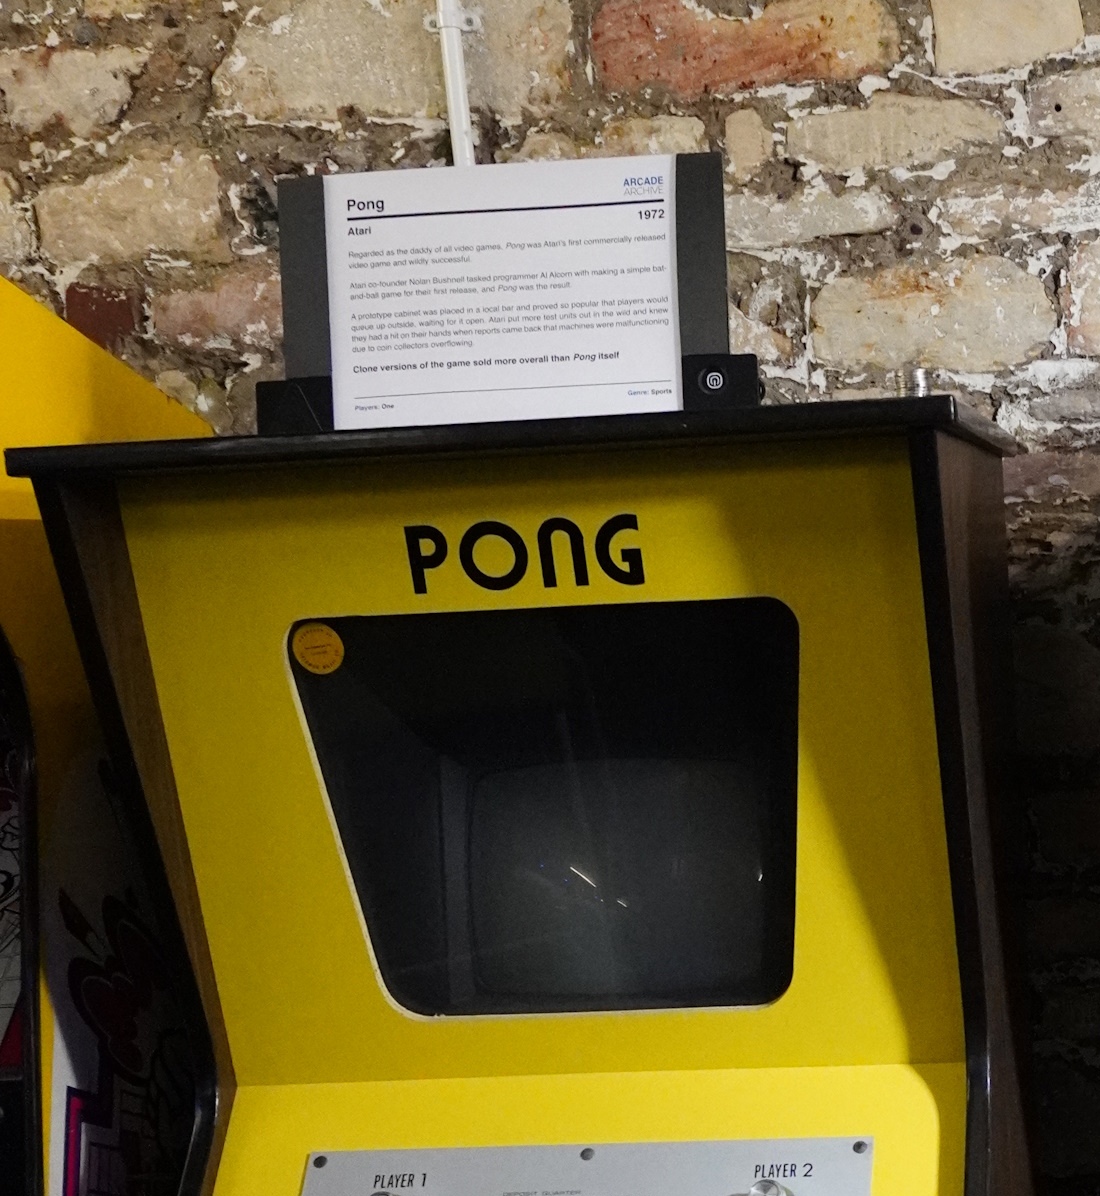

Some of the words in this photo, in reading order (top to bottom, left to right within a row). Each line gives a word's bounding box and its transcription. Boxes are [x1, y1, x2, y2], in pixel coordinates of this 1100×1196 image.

[623, 175, 663, 186] ARCADE
[623, 186, 664, 195] ARCHIVE
[346, 198, 384, 212] Pong
[637, 208, 664, 220] 1972
[347, 225, 371, 236] Atari
[347, 249, 384, 259] Regarded
[409, 246, 432, 254] daddy
[505, 241, 525, 250] Pong
[567, 238, 581, 246] first
[583, 235, 632, 245] commercially
[633, 232, 665, 242] released
[348, 261, 368, 269] video
[369, 260, 391, 269] game
[392, 258, 406, 266] and
[407, 257, 428, 265] wildly
[367, 279, 407, 288] co-founder
[432, 275, 464, 284] Bushnell
[466, 274, 491, 282] tasked
[492, 273, 538, 282] programmer
[590, 268, 618, 276] making
[626, 265, 650, 274] simple
[652, 264, 666, 272] bat-
[349, 291, 379, 300] and-ball
[380, 291, 402, 300] game
[403, 289, 413, 297] for
[414, 288, 431, 296] their
[480, 285, 495, 293] and
[497, 284, 517, 292] Pong
[535, 282, 548, 290] the
[357, 312, 392, 320] prototype
[393, 309, 421, 317] cabinet
[439, 306, 464, 316] placed
[482, 305, 499, 313] local
[515, 303, 530, 311] and
[532, 302, 558, 311] proved
[570, 300, 598, 309] popular
[617, 298, 644, 306] players
[645, 295, 668, 303] would
[350, 324, 374, 332] queue
[418, 319, 444, 327] waiting
[507, 315, 519, 323] put
[615, 308, 630, 316] wild
[632, 307, 647, 315] and
[428, 329, 451, 337] hands
[474, 327, 500, 335] reports
[558, 322, 594, 330] machines
[615, 318, 669, 326] malfunctioning
[393, 342, 428, 350] collectors
[352, 365, 378, 373] Clone
[379, 363, 417, 371] versions
[419, 361, 428, 369] of
[430, 360, 444, 368] the
[446, 360, 470, 369] game
[472, 358, 491, 366] sold
[518, 355, 548, 364] overall
[550, 354, 570, 362] than
[573, 353, 596, 362] Pong
[598, 351, 619, 359] itself
[403, 513, 646, 595] PONG
[754, 1163, 797, 1179] PLAYER
[802, 1162, 814, 1178] 2
[373, 1173, 415, 1189] PLAYER
[421, 1172, 427, 1188] 1
